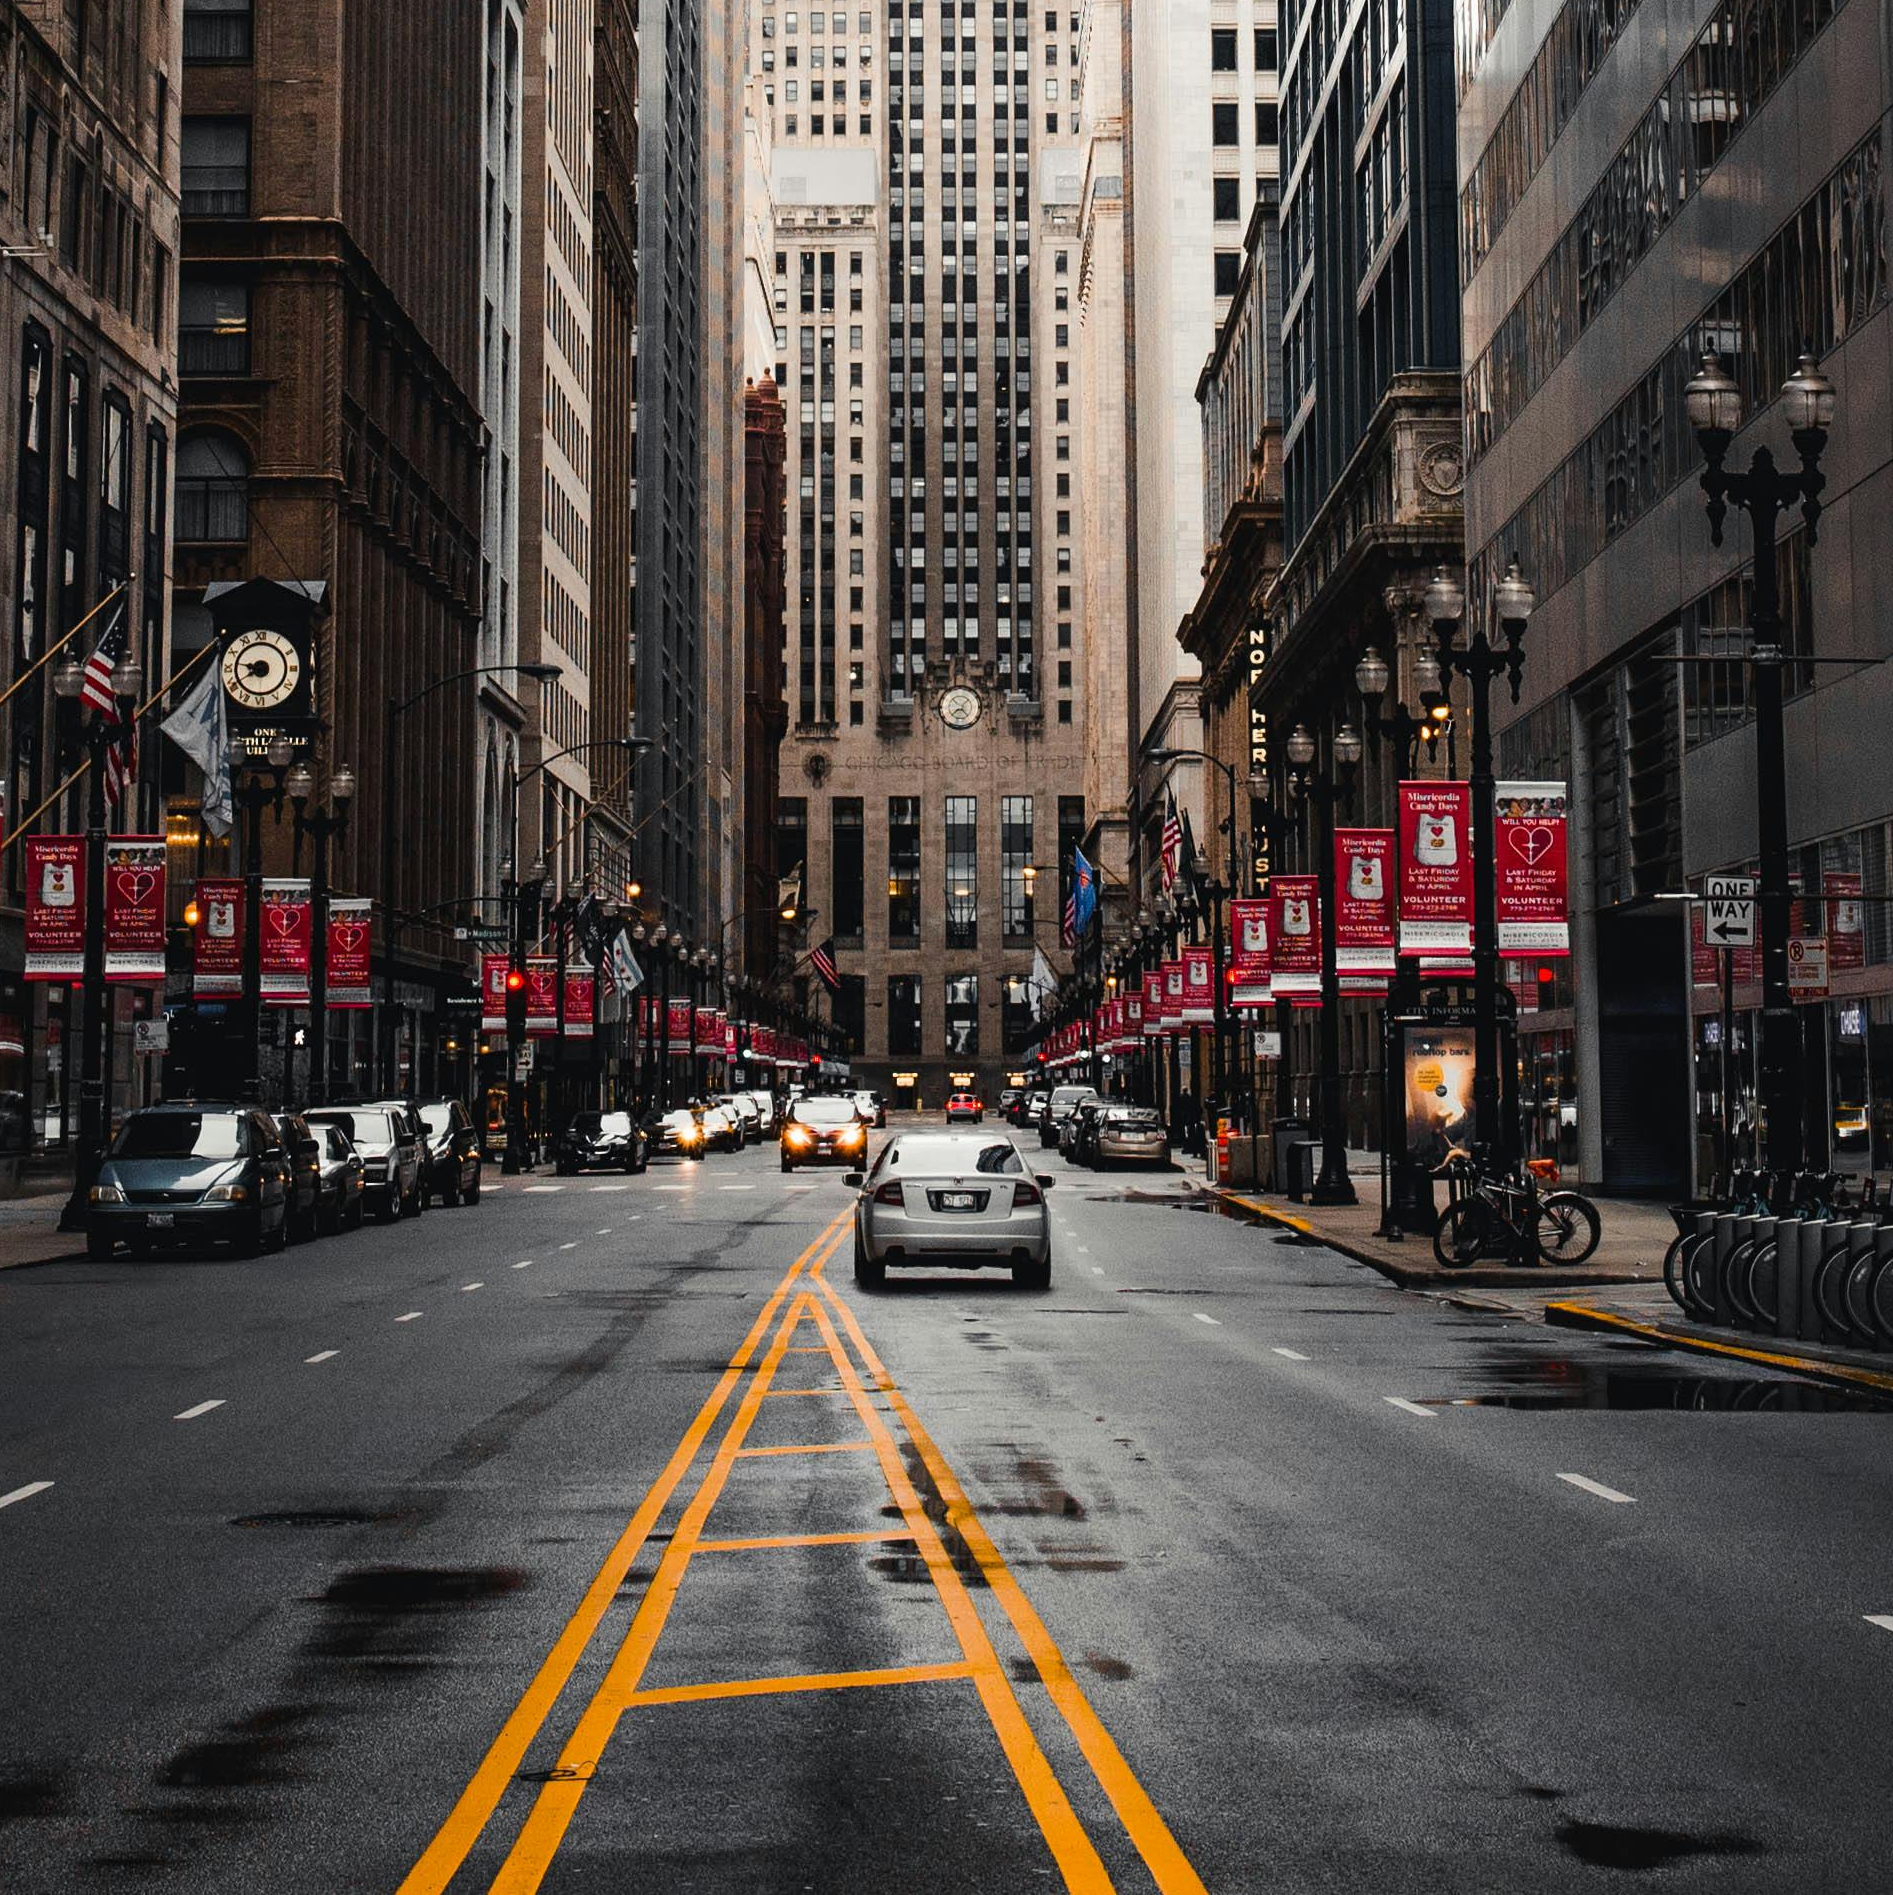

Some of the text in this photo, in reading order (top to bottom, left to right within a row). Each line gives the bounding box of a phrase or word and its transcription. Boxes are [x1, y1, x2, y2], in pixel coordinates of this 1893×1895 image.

[1408, 793, 1460, 802] Misericordia
[1410, 802, 1458, 811] Candy Days
[1712, 882, 1749, 897] ONE
[1404, 896, 1466, 904] VOLUNTEER
[1502, 897, 1563, 905] VOLUNTEER
[1711, 903, 1749, 918] WAY
[1406, 1006, 1476, 1015] CITY INFORMA
